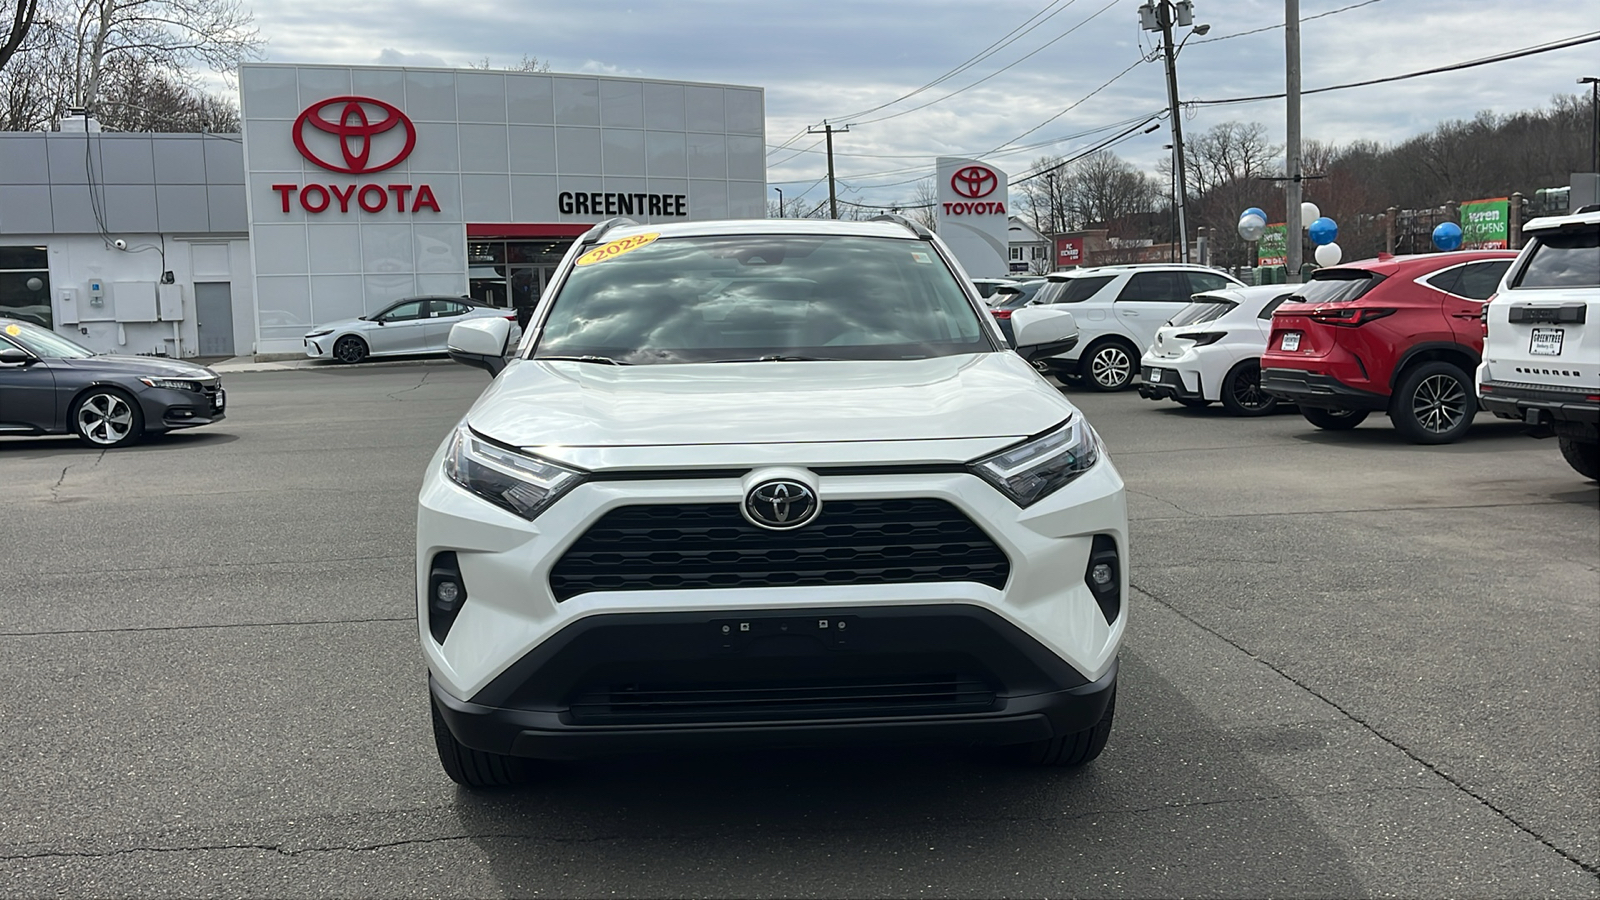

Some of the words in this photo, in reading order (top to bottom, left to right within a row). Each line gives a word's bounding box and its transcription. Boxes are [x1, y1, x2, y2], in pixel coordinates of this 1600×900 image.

[271, 183, 442, 214] TOYOTA
[558, 191, 688, 217] GREENTREE
[942, 201, 1007, 216] TOYOTA
[592, 235, 648, 261] 2022
[1533, 333, 1562, 344] GREENTREE
